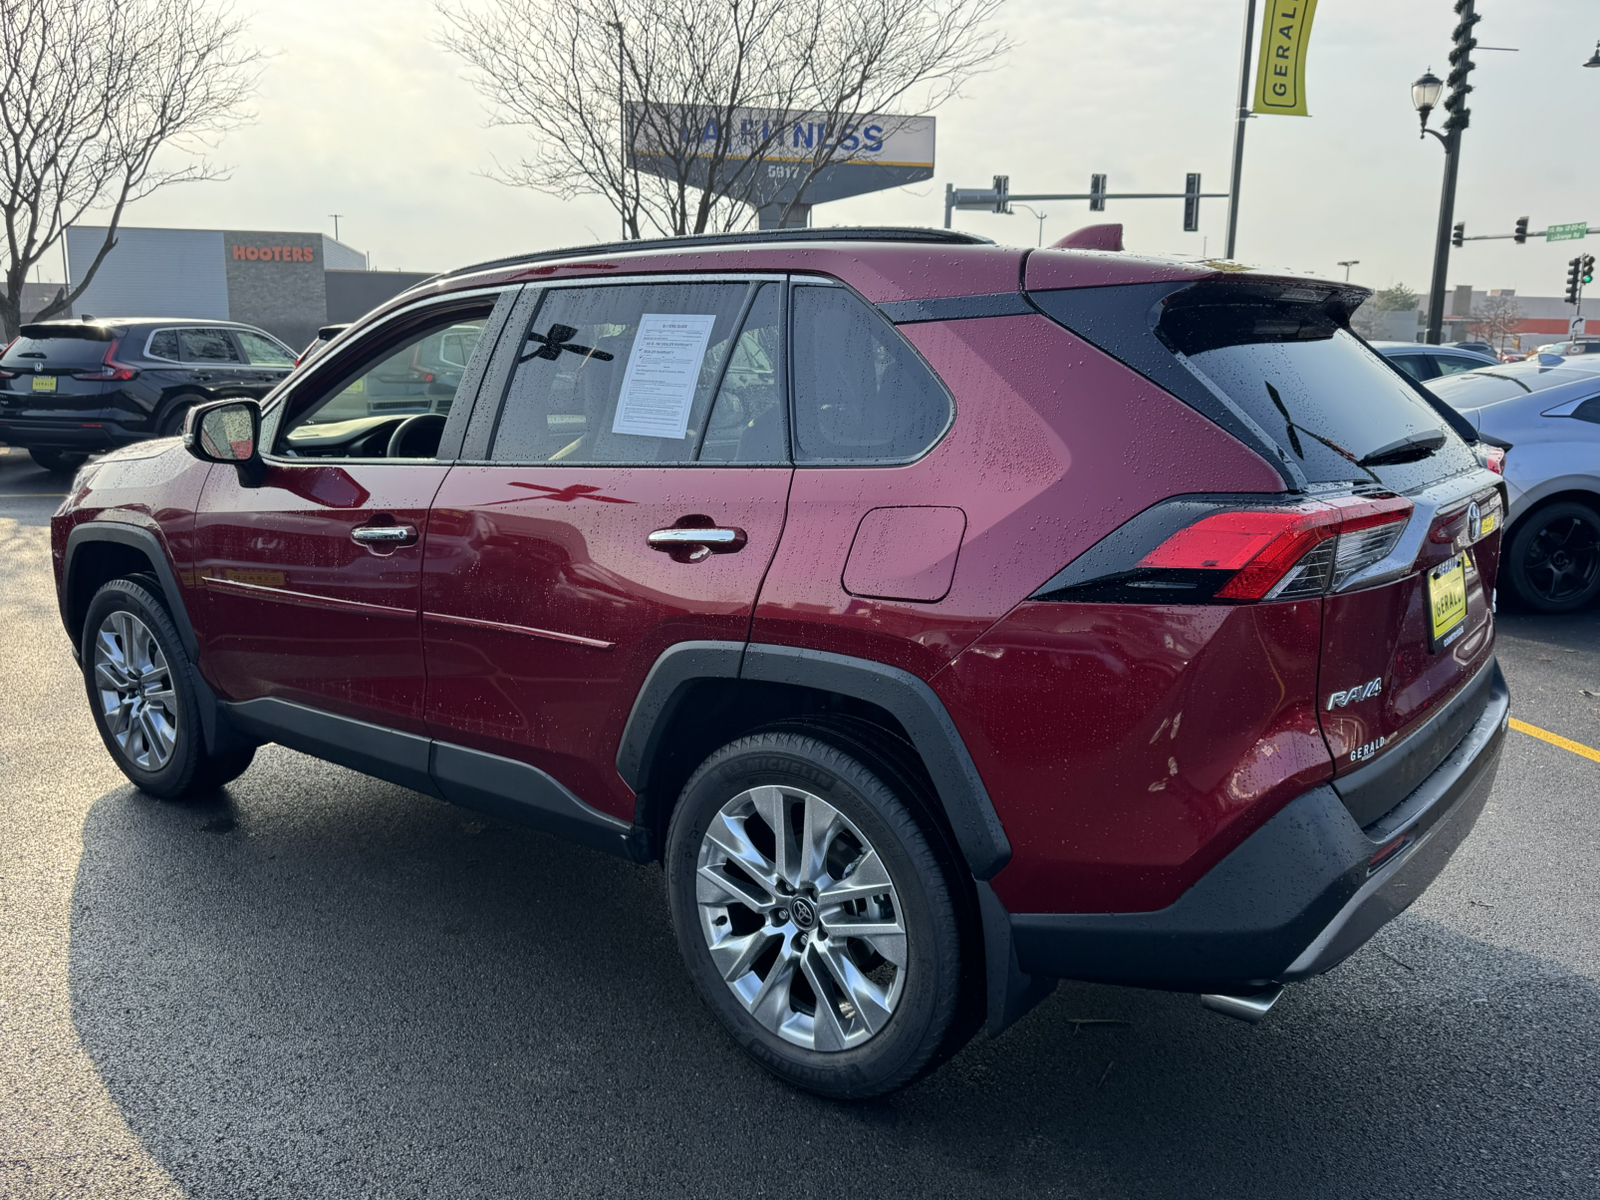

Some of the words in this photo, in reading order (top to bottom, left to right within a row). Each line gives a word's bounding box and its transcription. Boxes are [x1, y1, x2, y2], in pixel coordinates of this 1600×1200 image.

[1272, 0, 1298, 97] GERAL
[740, 119, 884, 152] FITNESS
[233, 245, 315, 262] HOOTERS
[1326, 677, 1382, 711] RAV4
[1350, 736, 1385, 761] GERALD
[746, 758, 830, 788] MICHELIN
[751, 1041, 835, 1083] MICHELIN
